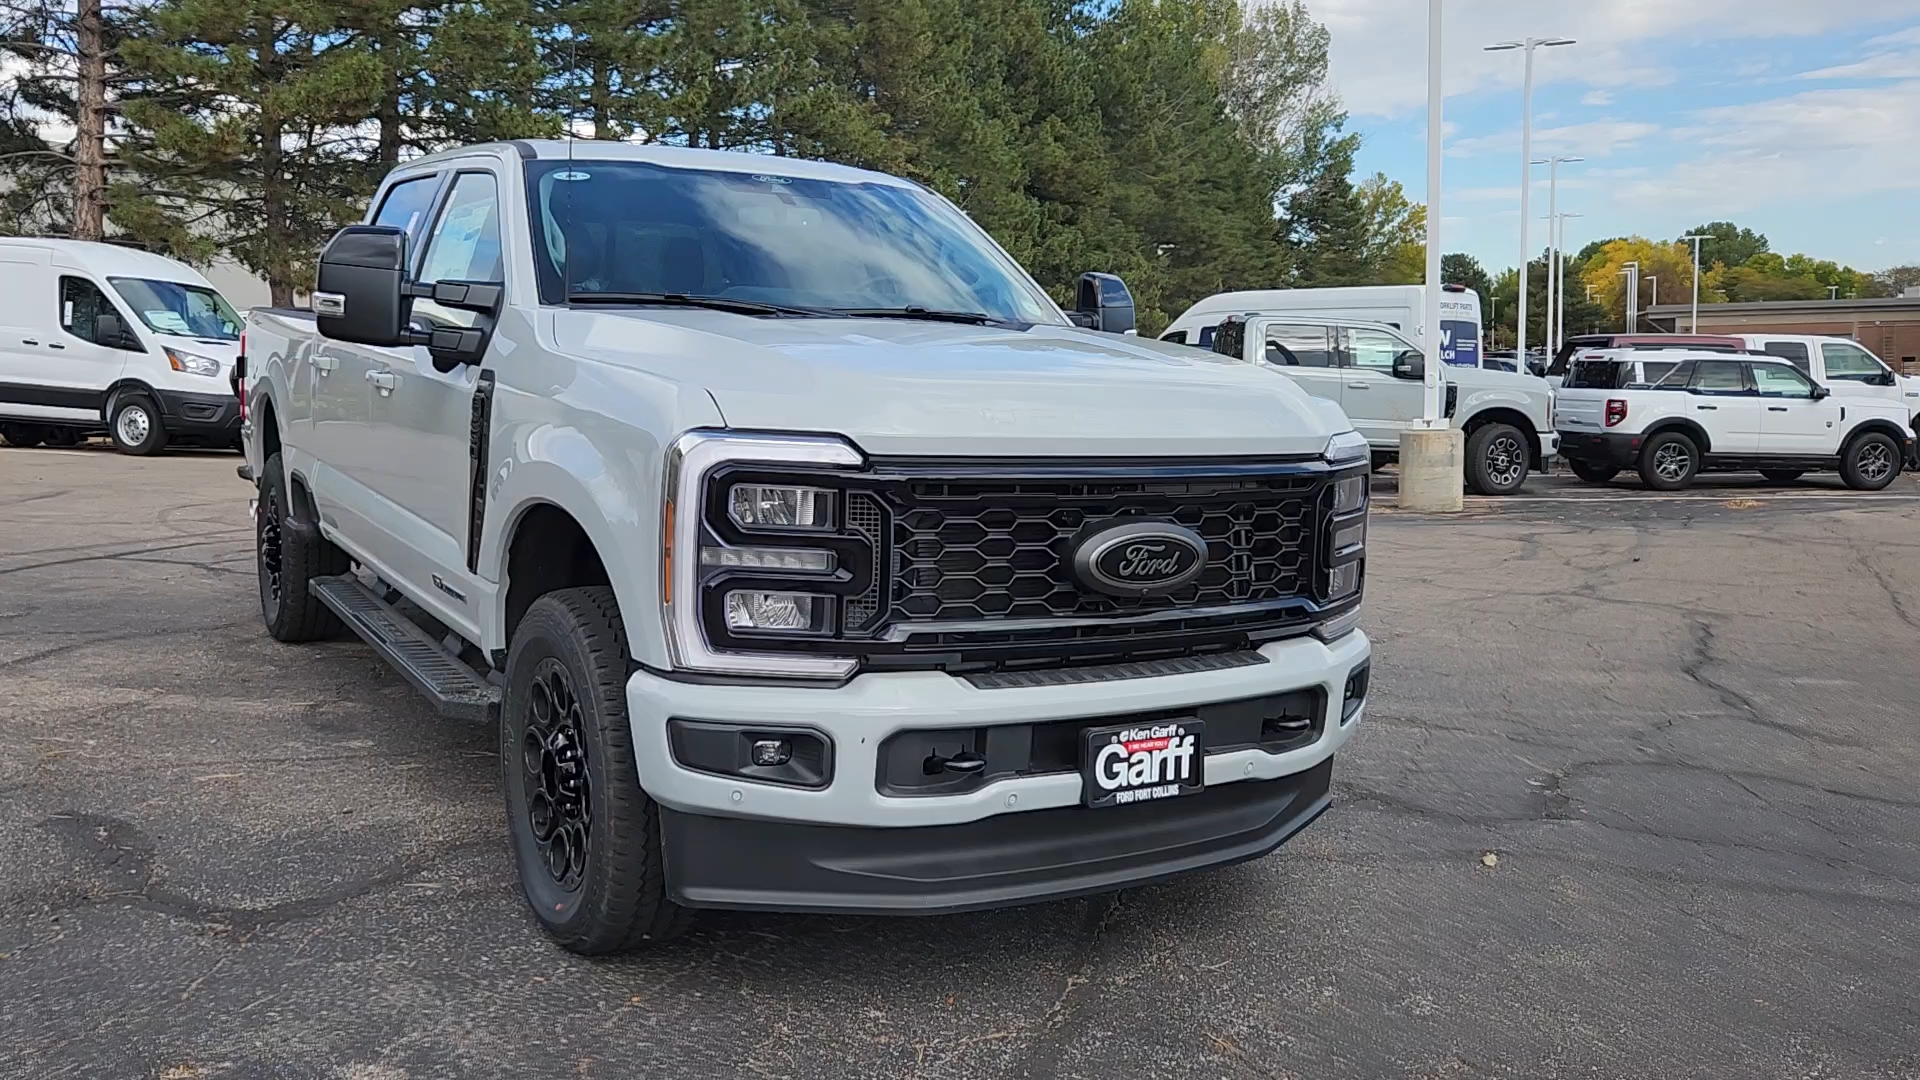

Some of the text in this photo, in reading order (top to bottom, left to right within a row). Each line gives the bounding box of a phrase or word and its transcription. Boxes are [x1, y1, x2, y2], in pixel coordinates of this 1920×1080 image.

[1440, 302, 1459, 310] ORKLIFT
[1440, 350, 1455, 360] LCH
[1119, 545, 1181, 576] Ford
[1129, 728, 1150, 741] Ken
[1150, 724, 1177, 739] Garff
[1095, 735, 1195, 790] Garff
[1116, 784, 1179, 804] FORD FORT COLLINS
